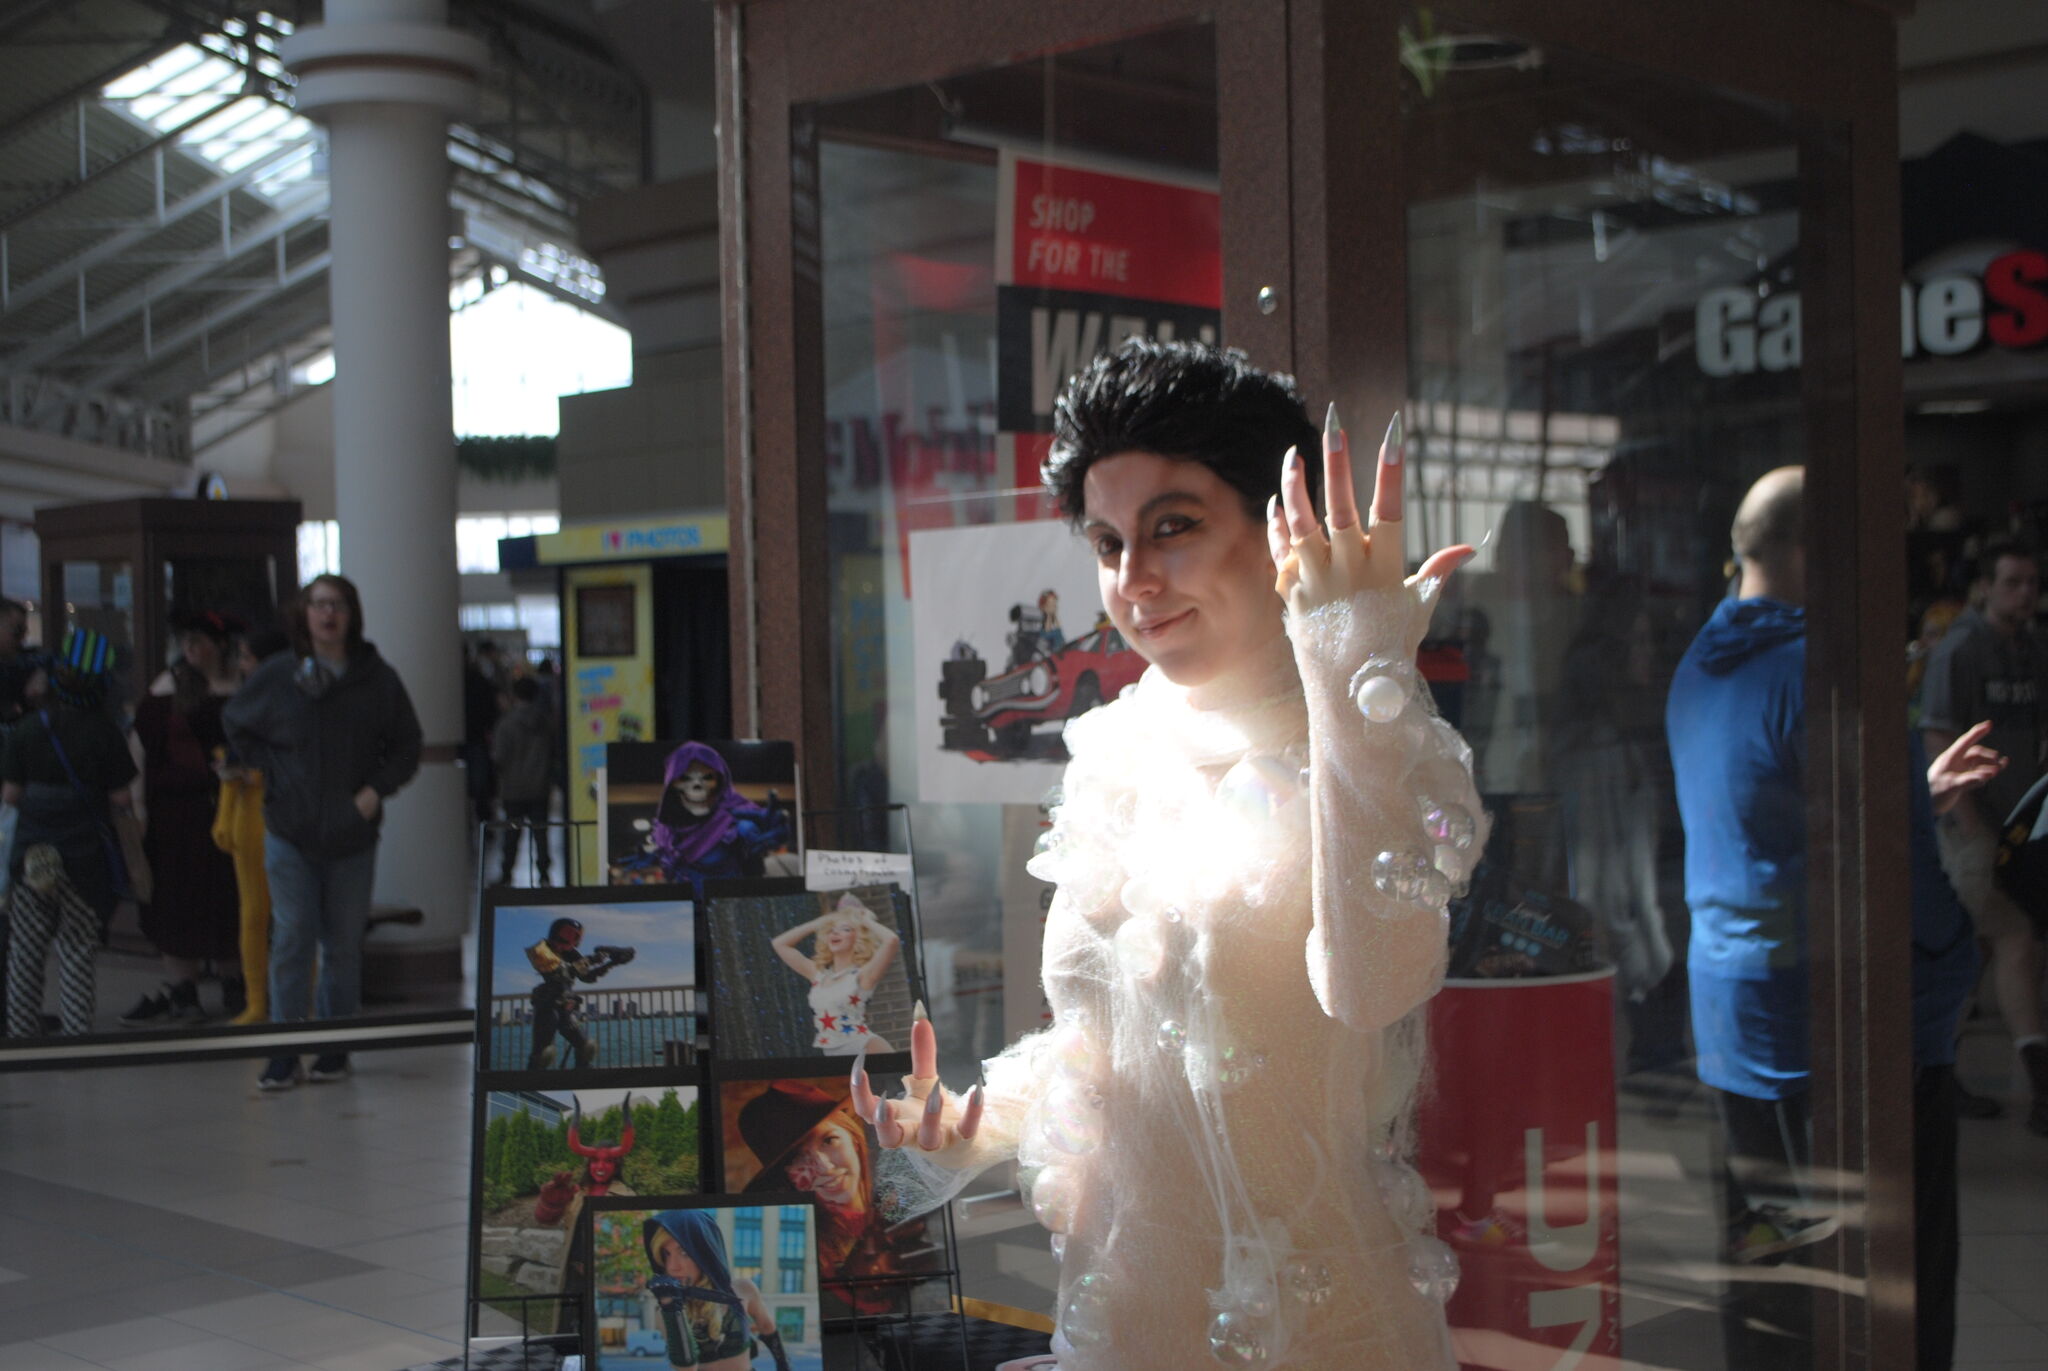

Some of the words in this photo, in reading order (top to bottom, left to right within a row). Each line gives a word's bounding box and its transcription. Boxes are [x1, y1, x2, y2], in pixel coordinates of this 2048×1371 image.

[1029, 196, 1095, 233] SHOP
[1028, 238, 1082, 277] FOR
[1089, 244, 1130, 283] THE
[1695, 250, 2048, 377] GaeS
[626, 525, 699, 549] PHOTOS
